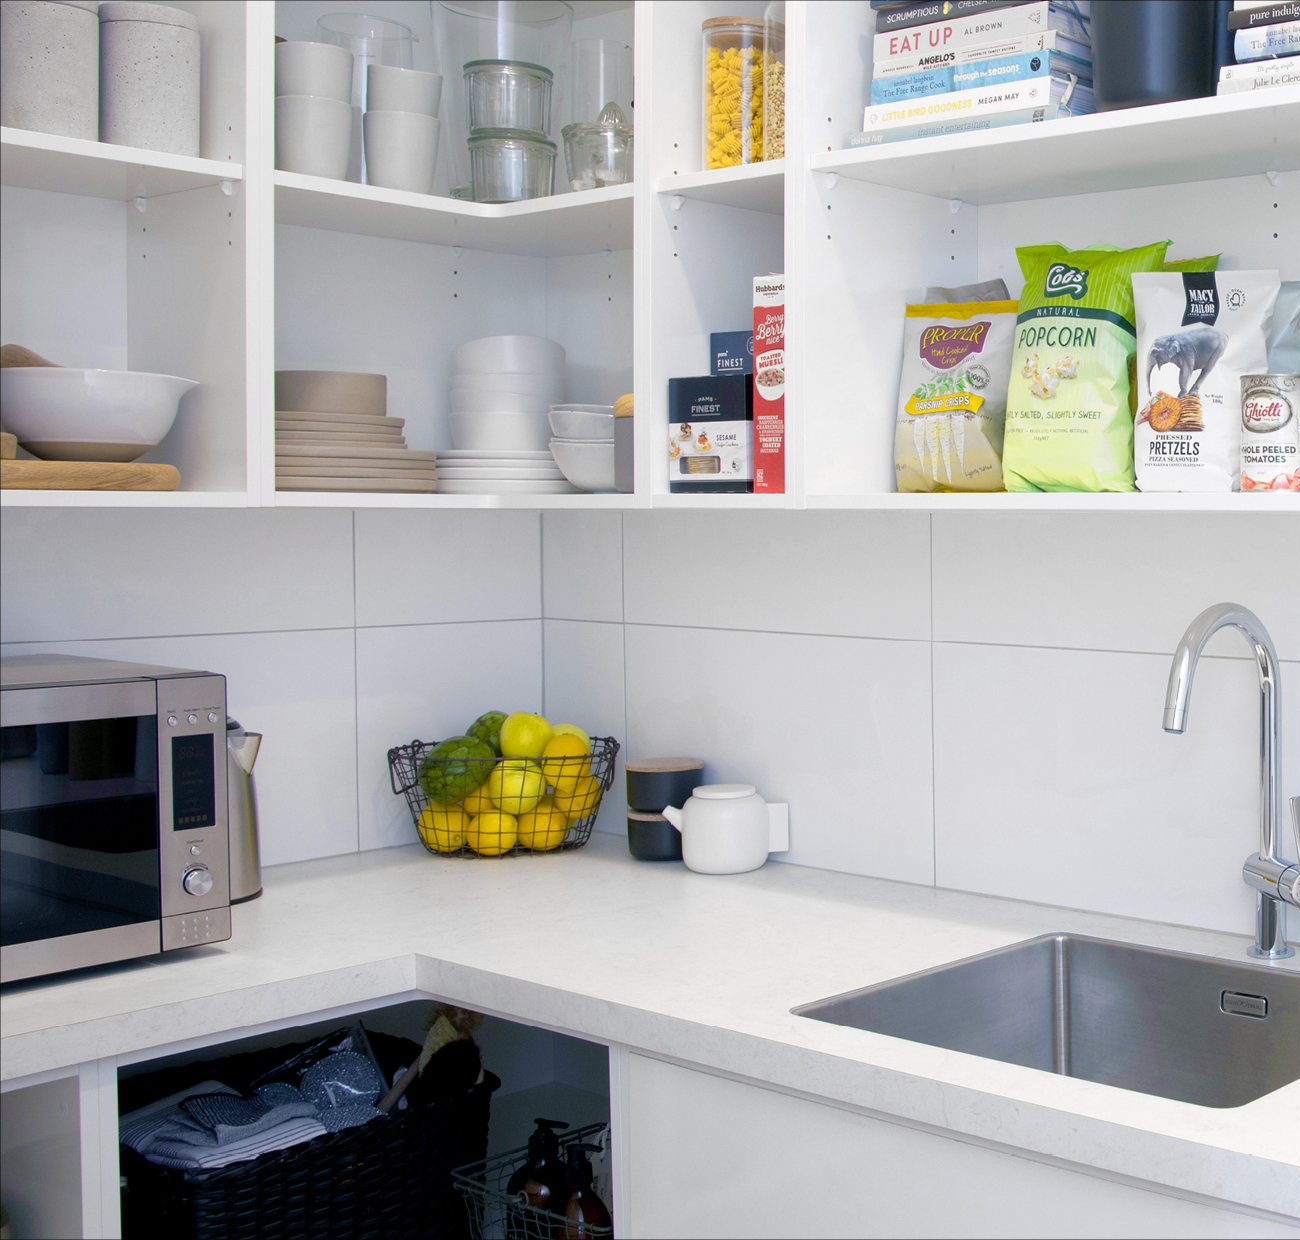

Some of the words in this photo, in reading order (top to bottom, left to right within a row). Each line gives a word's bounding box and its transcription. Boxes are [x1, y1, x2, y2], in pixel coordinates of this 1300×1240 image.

[886, 5, 939, 24] SCRUMPTIOUS
[1249, 10, 1270, 25] pure
[964, 27, 973, 36] AL
[975, 21, 1003, 34] BROWN
[1265, 25, 1291, 37] annabel
[889, 32, 922, 56] EAT
[928, 26, 953, 48] UP
[1250, 40, 1266, 50] The
[1268, 36, 1286, 47] Free
[918, 52, 956, 67] ANGELO'S
[953, 70, 979, 83] through
[988, 64, 1020, 77] seasons
[894, 76, 913, 87] annabel
[1252, 77, 1269, 90] Julie
[1271, 76, 1281, 85] Le
[883, 89, 894, 98] The
[896, 86, 909, 96] Free
[910, 84, 928, 95] Range
[929, 81, 945, 91] Cook
[978, 95, 1002, 106] MEGAN
[1005, 92, 1020, 101] MAY
[882, 109, 906, 122] LITTLE
[907, 107, 926, 118] BIRD
[928, 99, 972, 114] GOODNESS
[917, 126, 944, 136] instant
[945, 119, 991, 134] entertaining
[850, 135, 870, 146] donna
[872, 133, 883, 144] hay
[1189, 289, 1214, 302] MACY
[1036, 307, 1081, 317] NATURAL
[1191, 304, 1215, 314] TAILOR
[765, 314, 785, 326] Berry
[755, 323, 785, 341] Berry
[922, 324, 984, 350] PROPER
[1018, 326, 1098, 349] POPCORN
[765, 335, 781, 345] nice
[717, 357, 743, 368] FINEST
[759, 358, 783, 369] MUESLI
[760, 353, 781, 361] TOASTED
[691, 404, 721, 414] FINEST
[914, 399, 943, 411] PARSNIP
[944, 395, 970, 408] CRISPS
[1020, 411, 1043, 420] SALTED,
[1046, 411, 1077, 420] SLIGHTLY
[1077, 411, 1101, 420] SWEET
[1245, 402, 1283, 423] Ghiotti
[1149, 441, 1200, 456] PRETZELS
[1242, 446, 1260, 454] HOLE
[1263, 446, 1296, 454] PEELED
[1244, 455, 1286, 464] TOMATOES
